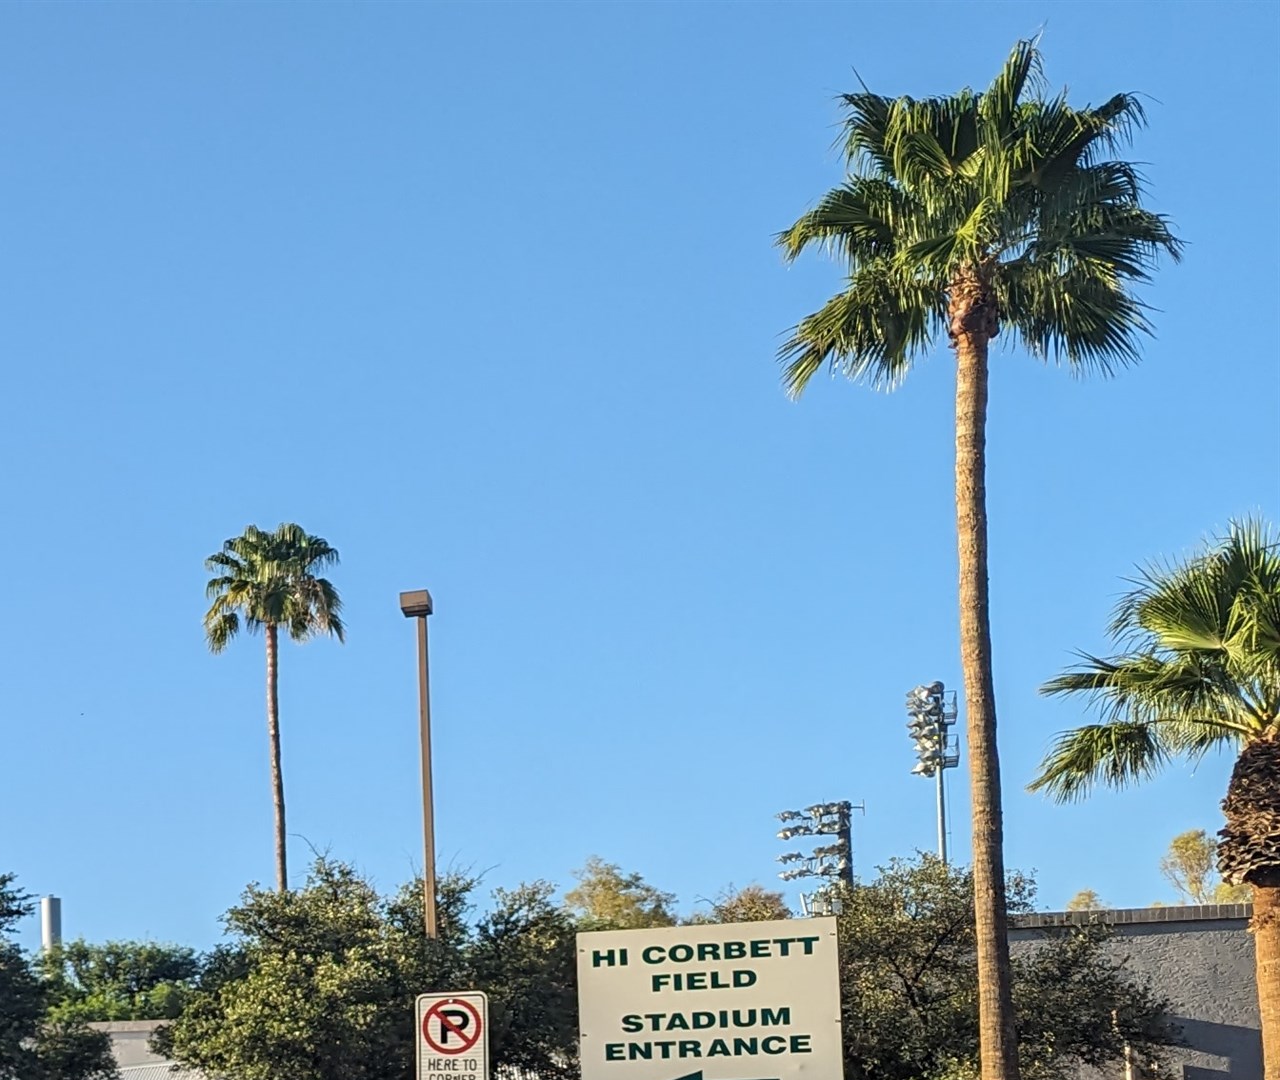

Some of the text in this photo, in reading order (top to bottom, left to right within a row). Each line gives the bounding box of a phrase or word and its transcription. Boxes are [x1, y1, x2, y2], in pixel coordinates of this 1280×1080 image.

[592, 936, 820, 968] HI CORBETT
[651, 969, 758, 993] FIELD
[440, 1009, 470, 1045] P
[621, 1007, 791, 1033] STADIUM
[605, 1034, 813, 1061] ENTRANCE
[427, 1058, 478, 1072] HERE TO
